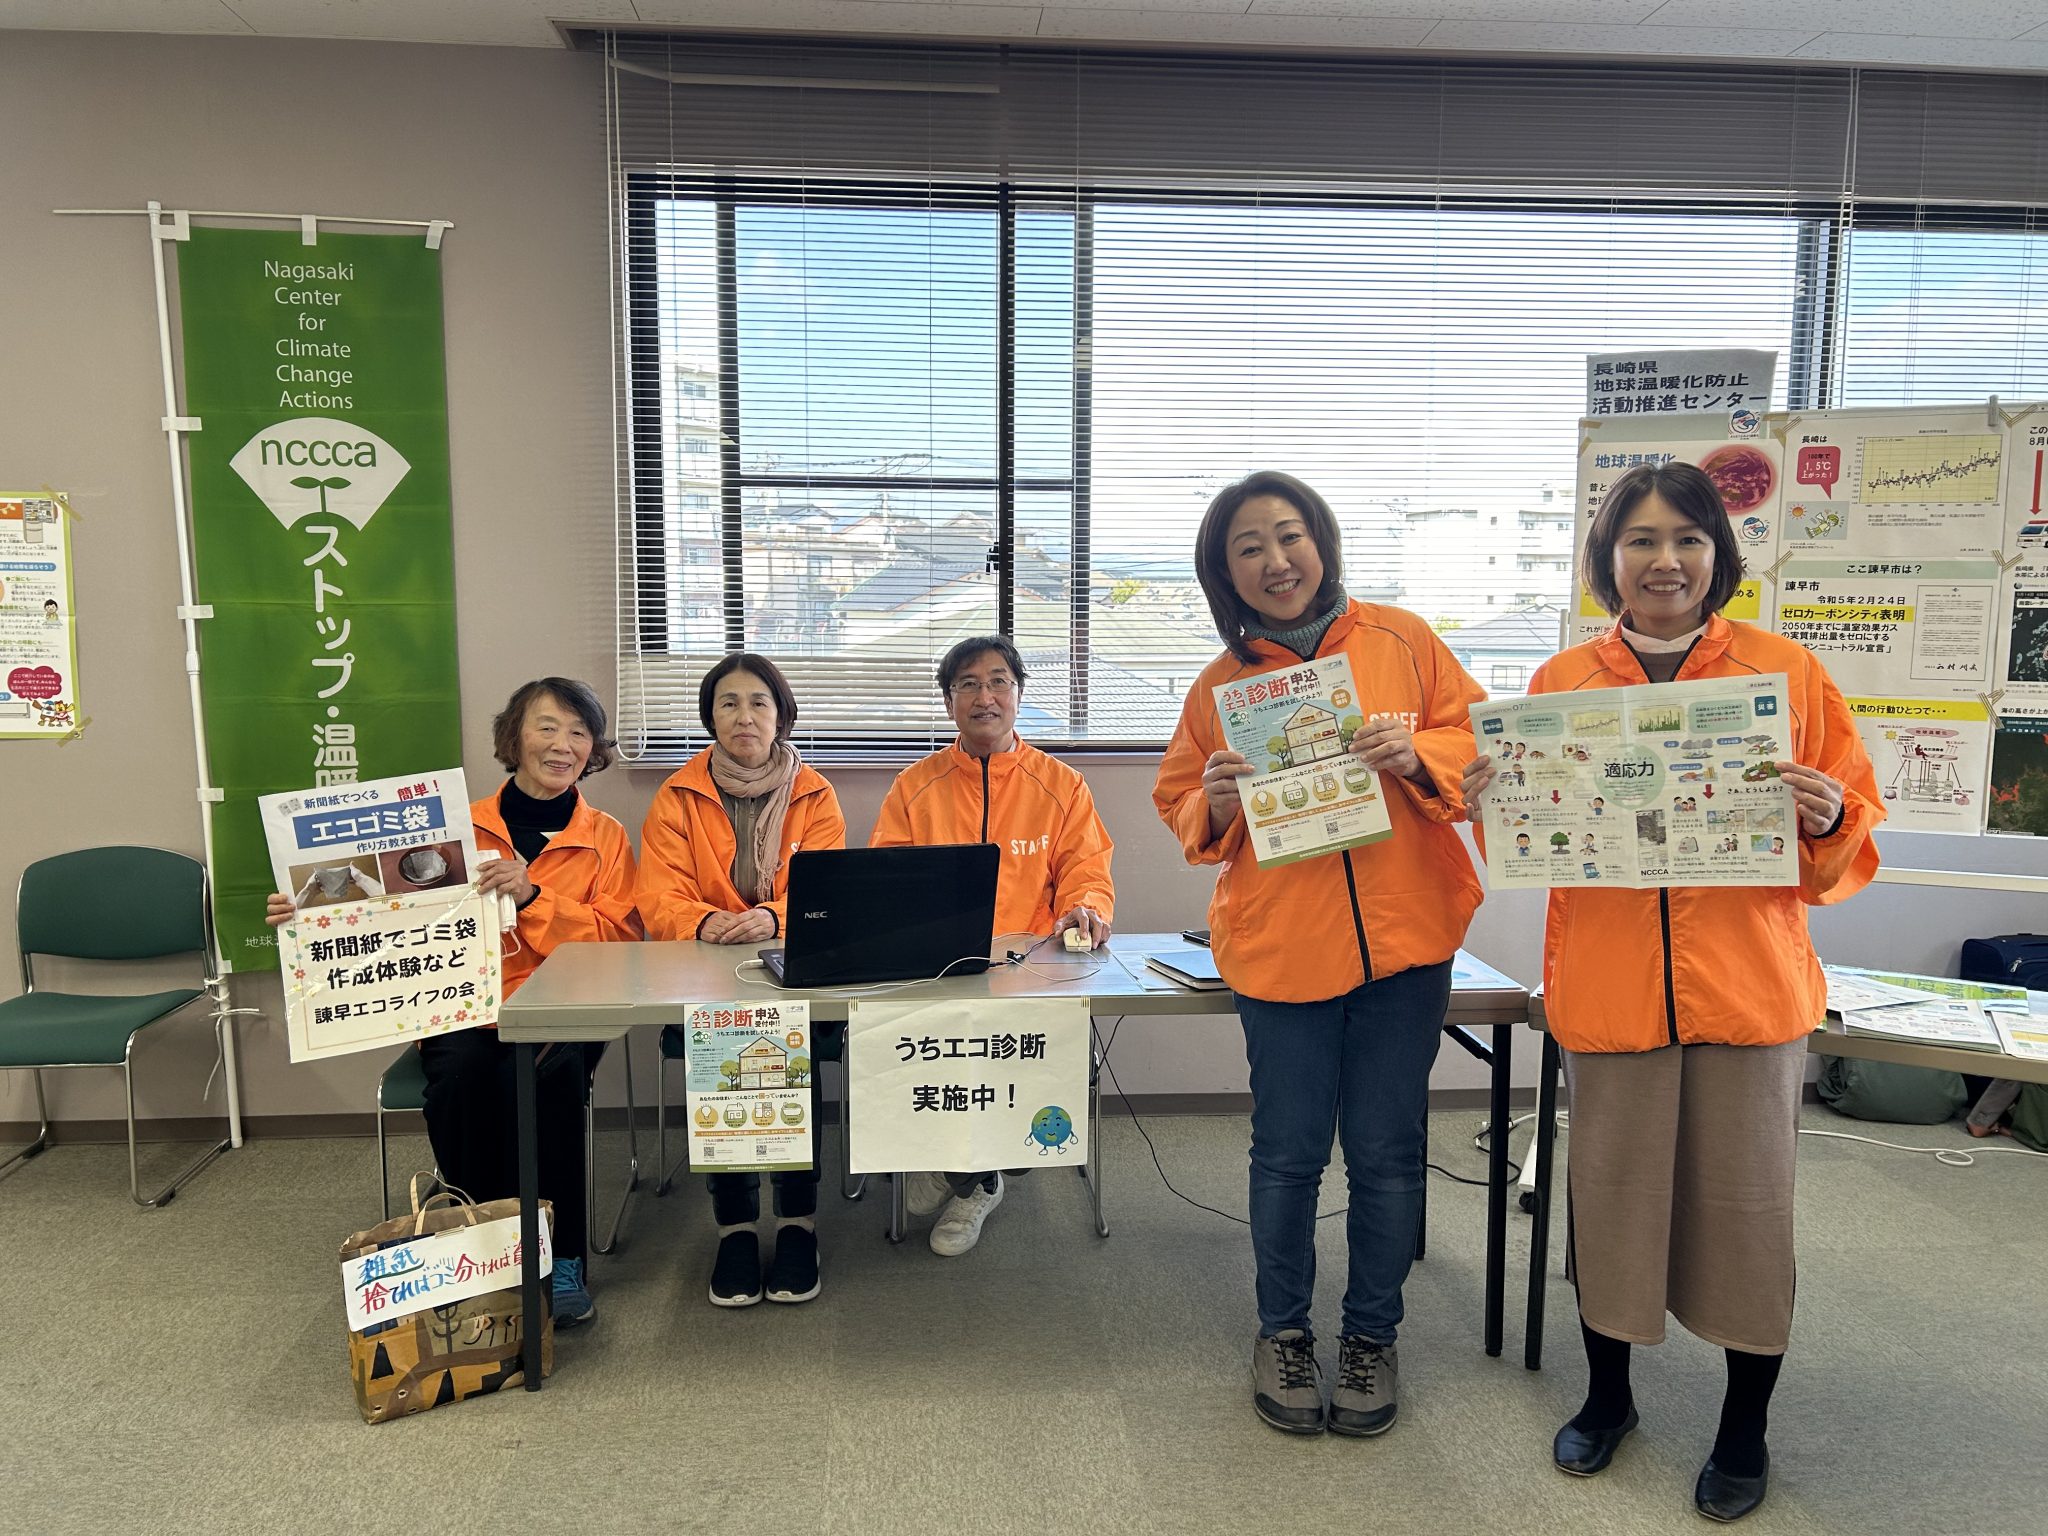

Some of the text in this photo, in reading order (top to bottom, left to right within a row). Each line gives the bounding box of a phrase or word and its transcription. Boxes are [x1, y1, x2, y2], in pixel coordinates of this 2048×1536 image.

[264, 260, 354, 283] Nagasaki
[274, 287, 342, 306] Center
[298, 312, 326, 331] for
[275, 338, 352, 358] Climate
[275, 364, 353, 387] Change
[1594, 361, 1658, 375] 長崎県
[1594, 373, 1749, 392] 地球温暖化防止
[279, 390, 354, 410] Actions
[1592, 392, 1768, 414] 活動推進センター
[1801, 435, 1828, 443] 長崎は
[2029, 437, 2048, 446] 8月
[260, 438, 377, 468] nccca
[1784, 581, 1821, 592] 諫早市
[1781, 607, 1906, 621] ゼロカーボンシティ表明
[1781, 622, 1898, 632] 2050年までに温室効果ガス
[1781, 632, 1890, 641] の実質排出量をゼロにする
[1290, 668, 1319, 686] 申込
[1222, 689, 1243, 702] うち
[1245, 676, 1290, 706] 診断
[1224, 700, 1246, 712] エコ
[1603, 760, 1655, 779] 適応力
[304, 789, 379, 809] 新聞紙でつくる
[397, 779, 440, 802] 簡単！
[312, 806, 431, 843] エコゴミ袋
[356, 829, 449, 854] 作り方教えます！！
[1010, 834, 1049, 856] STAFF
[1640, 868, 1669, 876] NCCCA
[804, 910, 828, 919] NEC
[310, 917, 477, 962] 新聞紙でゴミ袋
[327, 946, 467, 990] 作成体験など
[314, 981, 476, 1024] 諫早エコライフの会
[692, 1010, 711, 1020] うち
[713, 1009, 753, 1029] 診断
[755, 1007, 780, 1020] 申込
[691, 1021, 711, 1029] エコ
[895, 1032, 1047, 1062] うちエコ診断
[912, 1083, 1016, 1112] 実施中！
[357, 1247, 420, 1284] 雑紙
